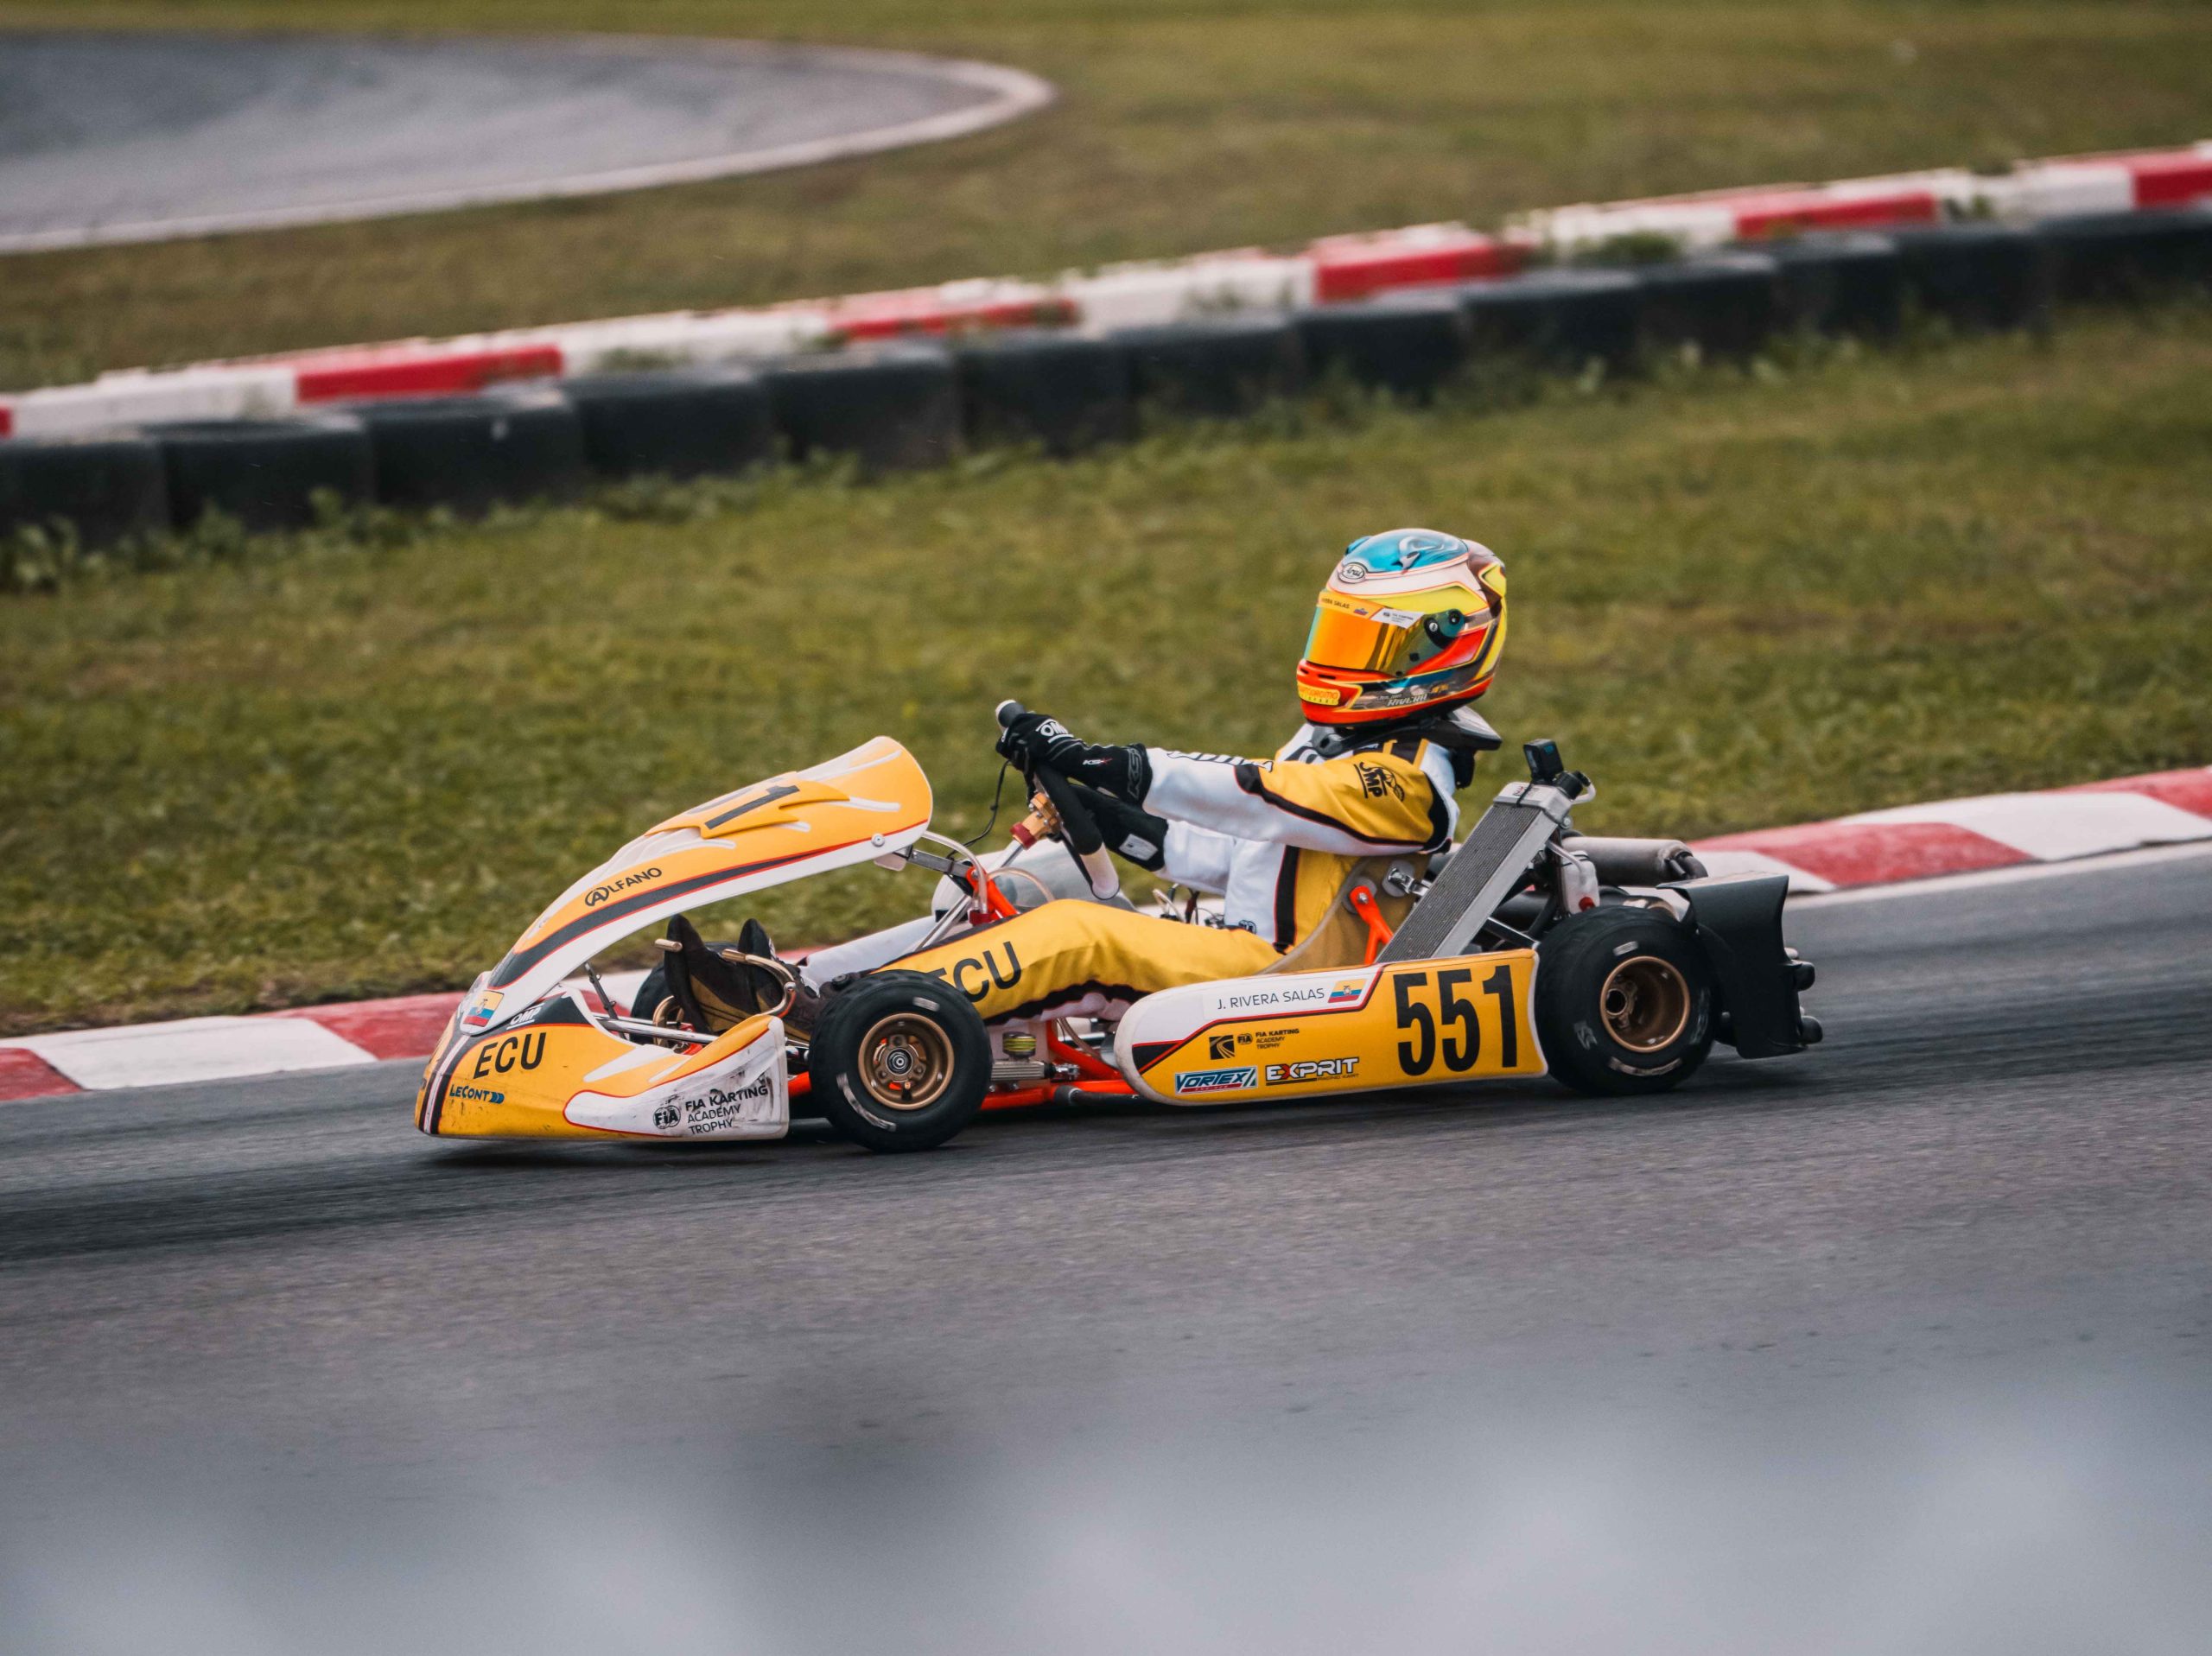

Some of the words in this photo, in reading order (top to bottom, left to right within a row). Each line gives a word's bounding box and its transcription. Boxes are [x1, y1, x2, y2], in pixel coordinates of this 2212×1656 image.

[1217, 999, 1227, 1010] J.
[1230, 993, 1279, 1008] RIVERA
[1282, 987, 1325, 1002] SALAS
[508, 1005, 543, 1026] OMP
[1392, 964, 1518, 1076] 551
[1268, 1028, 1300, 1037] KARTING
[473, 1031, 547, 1079] ECU
[1266, 1056, 1359, 1082] EXPRIT
[1176, 1072, 1249, 1093] VORTEX
[685, 1099, 706, 1112] FIA
[709, 1085, 768, 1107] KARTING
[688, 1104, 741, 1124] ACADEMY
[690, 1118, 734, 1135] TROPHY
